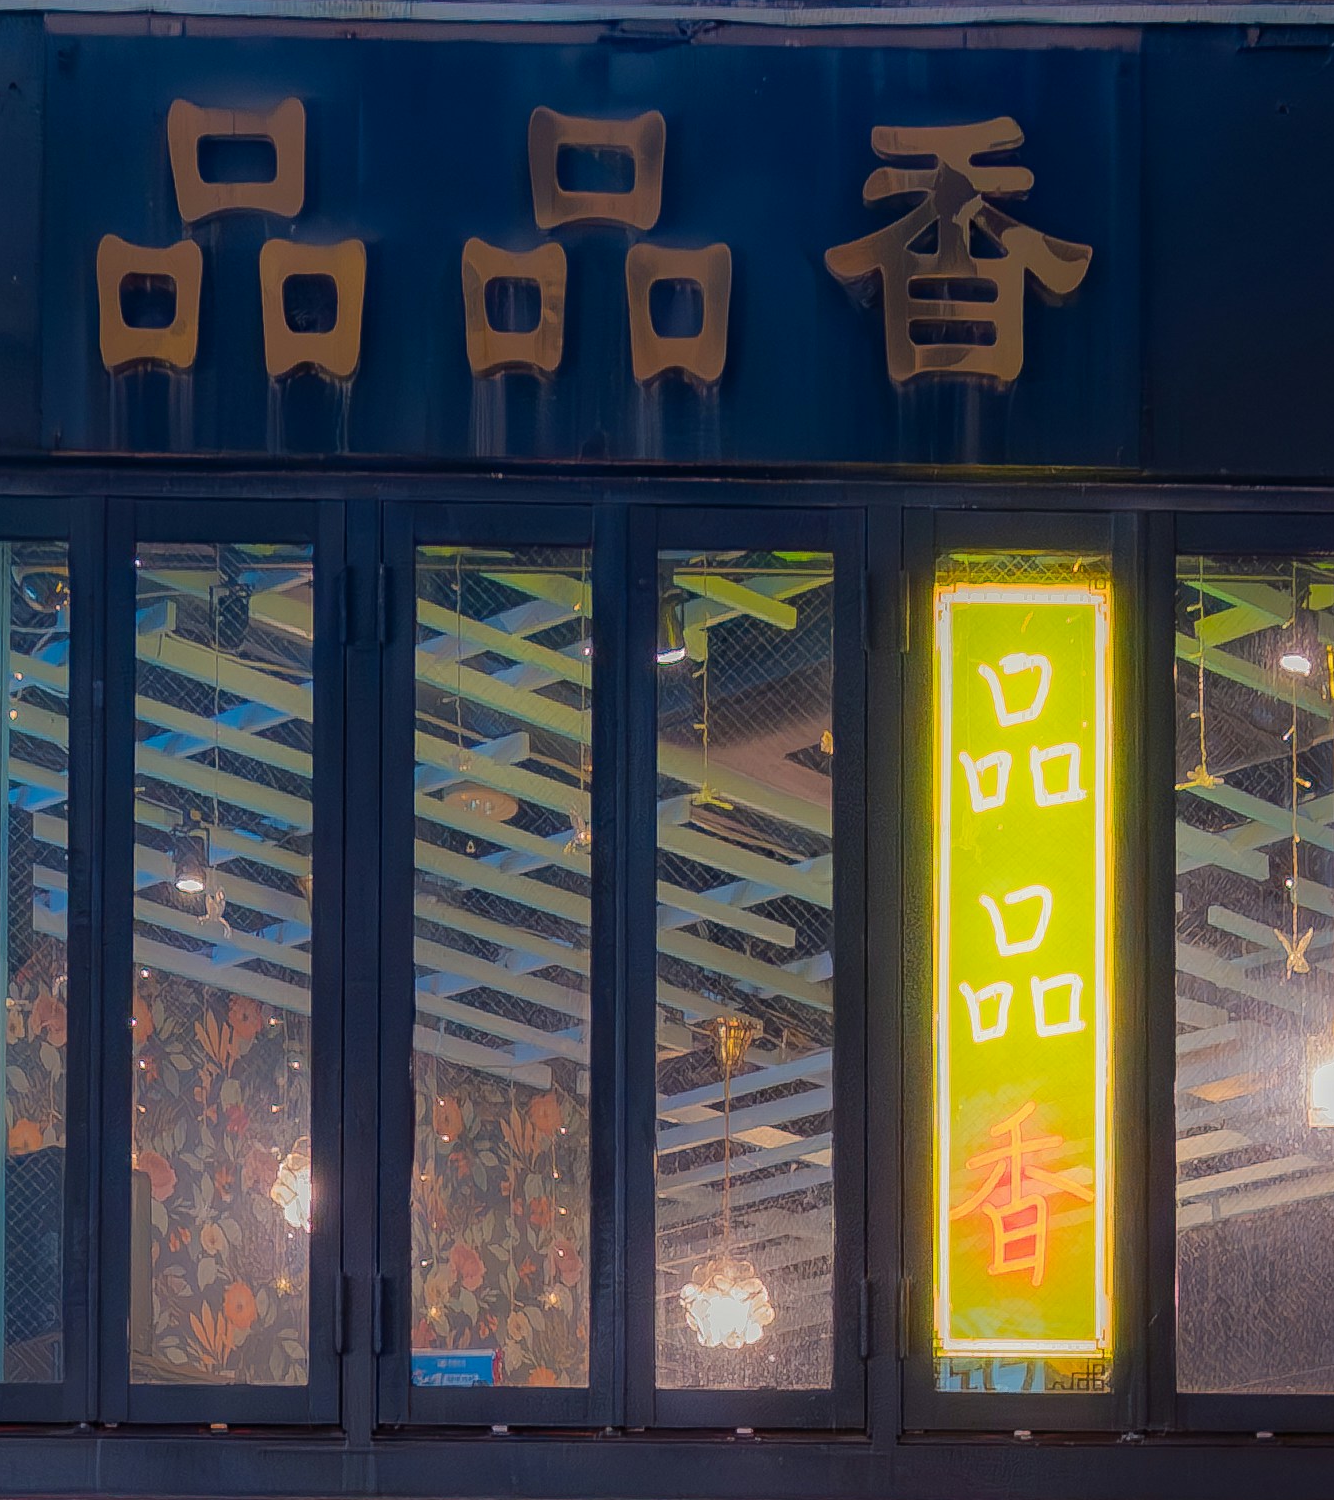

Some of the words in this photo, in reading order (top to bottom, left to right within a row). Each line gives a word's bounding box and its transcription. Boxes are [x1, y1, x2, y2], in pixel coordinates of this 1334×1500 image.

[97, 94, 1094, 386] 品品香
[950, 651, 1096, 1288] 品品香
